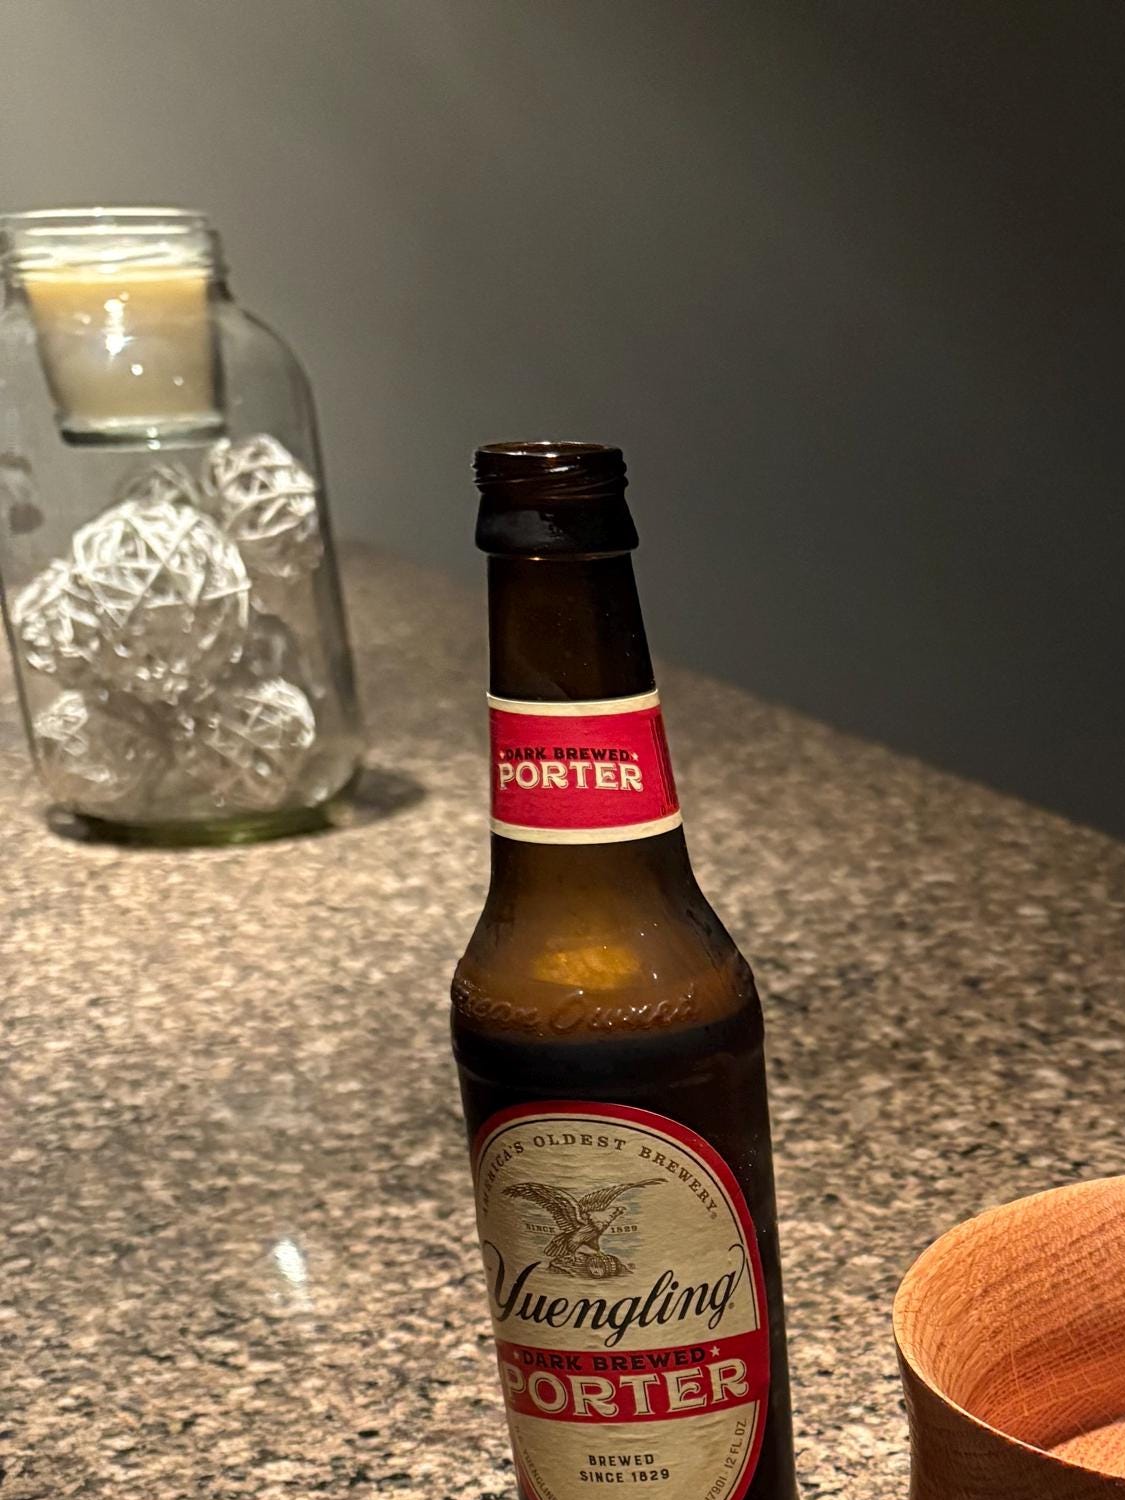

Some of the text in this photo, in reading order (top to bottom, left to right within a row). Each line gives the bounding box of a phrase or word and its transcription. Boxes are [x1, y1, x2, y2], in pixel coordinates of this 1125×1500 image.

[505, 747, 631, 761] DARK BREWED
[498, 760, 644, 792] PORTER
[533, 1133, 627, 1151] OLDEST
[638, 1146, 718, 1213] BREWERY
[483, 1240, 746, 1348] Yuengling
[523, 1347, 706, 1372] DARK BREWED
[503, 1358, 749, 1418] PORTER
[588, 1453, 655, 1468] BREWED
[724, 1456, 737, 1469] 12
[579, 1468, 670, 1484] SINCE 1829
